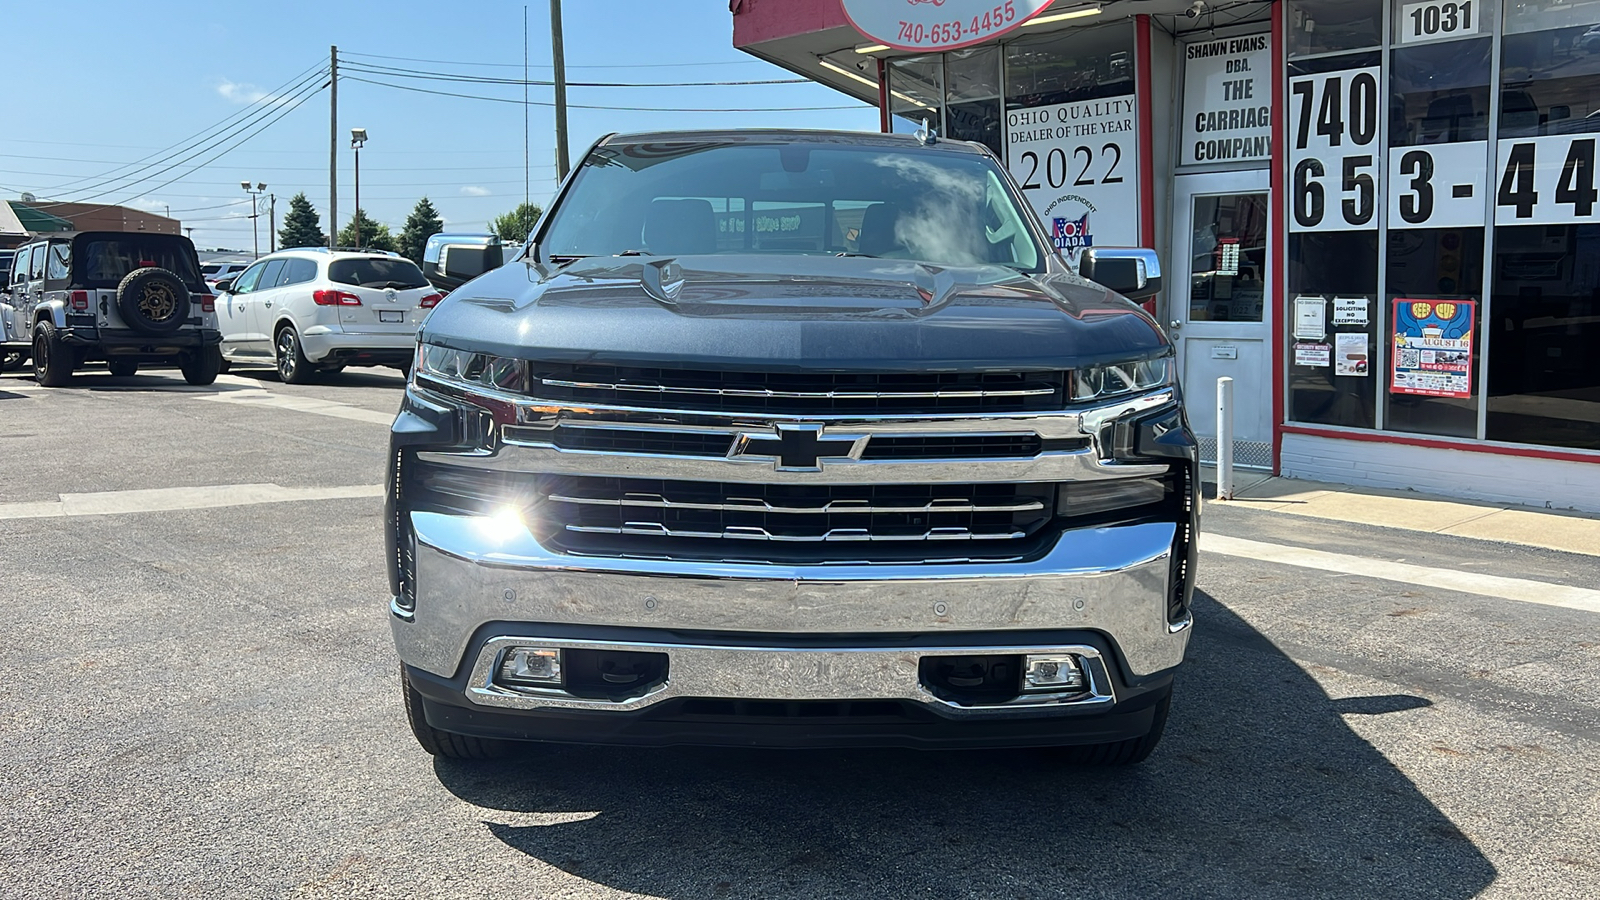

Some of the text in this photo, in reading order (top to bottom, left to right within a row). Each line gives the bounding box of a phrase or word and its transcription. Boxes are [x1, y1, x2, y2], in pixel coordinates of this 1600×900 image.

[897, 0, 1015, 44] 740-653-4455
[1410, 1, 1471, 36] 1031
[1187, 40, 1227, 60] SHAWN
[1225, 58, 1252, 74] DBA.
[1222, 79, 1254, 101] THE
[1008, 109, 1050, 127] OHIO
[1057, 99, 1134, 123] QUALITY
[1195, 106, 1272, 133] CARRIAG
[1293, 73, 1377, 150] 740
[1011, 119, 1133, 144] DEALER OF THE YEAR
[1021, 142, 1124, 190] 2022
[1044, 194, 1098, 217] OHIO INDEPENDENT
[1054, 236, 1086, 248] OIADA
[1422, 339, 1457, 347] AUGUST
